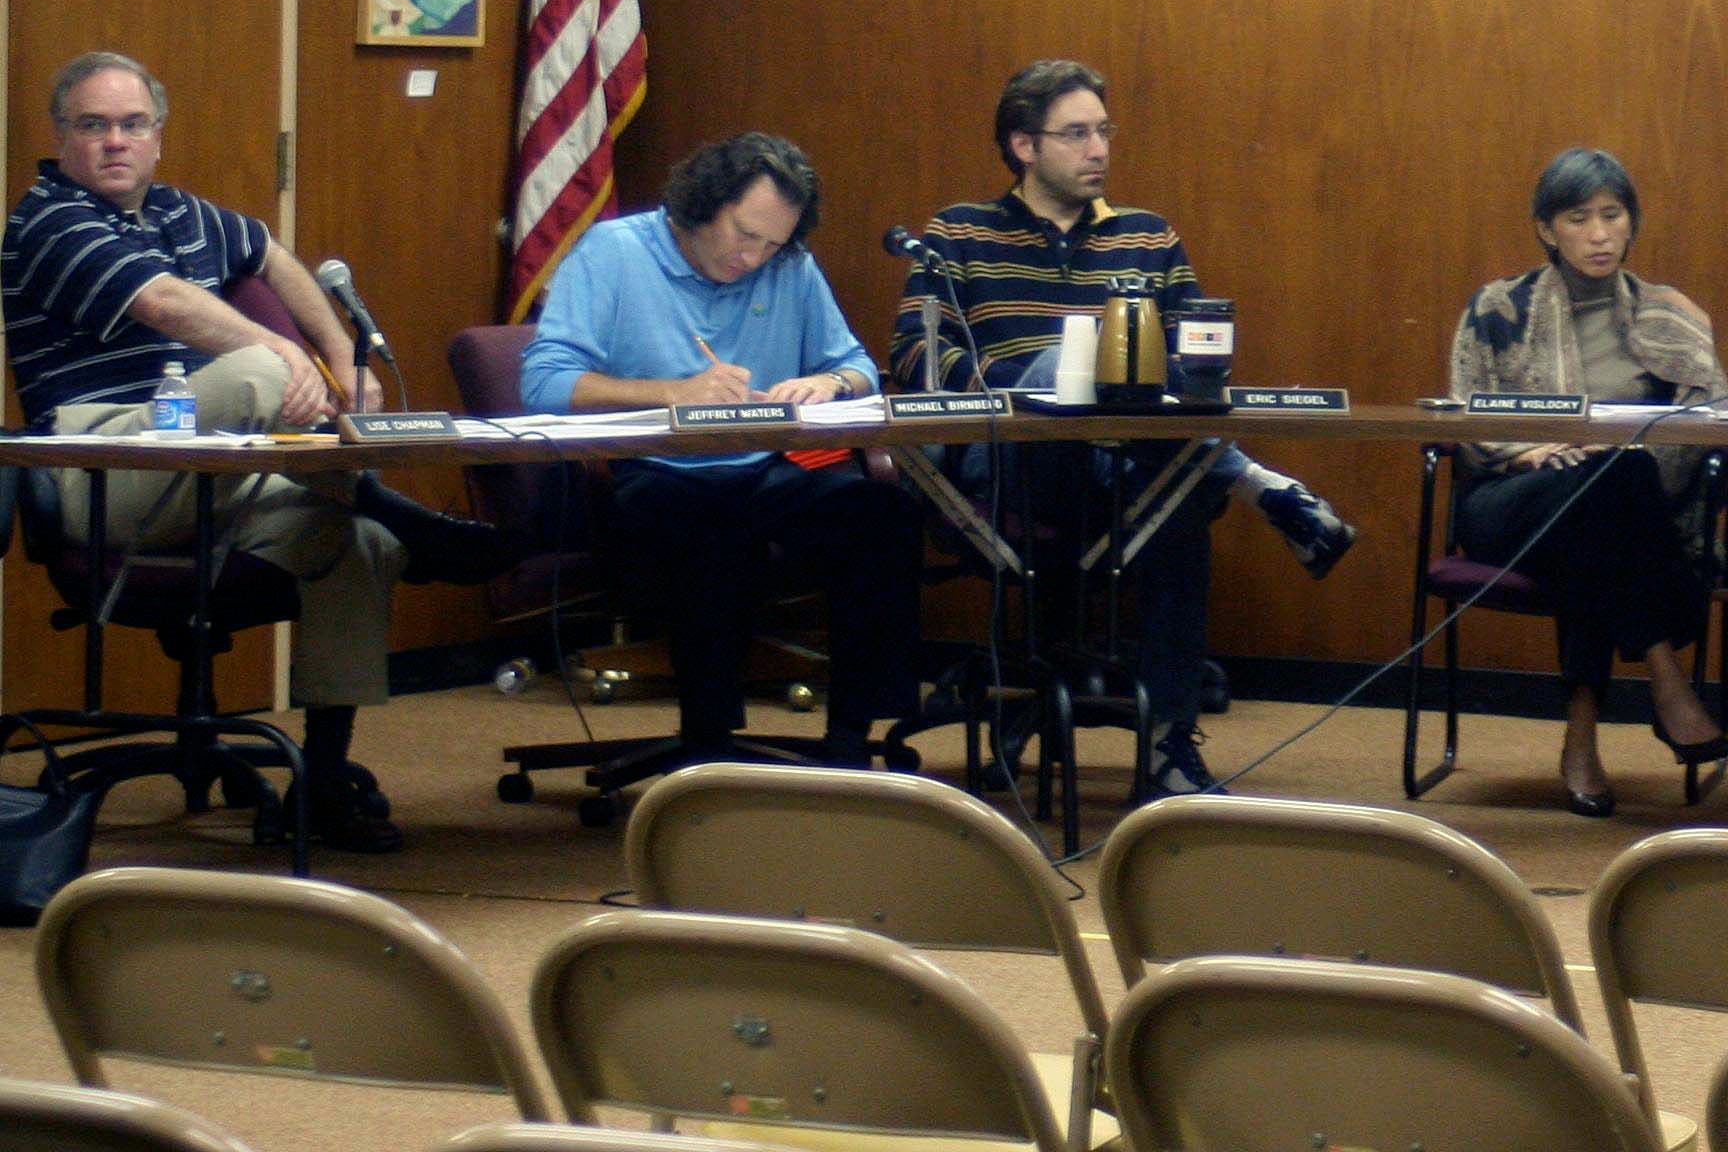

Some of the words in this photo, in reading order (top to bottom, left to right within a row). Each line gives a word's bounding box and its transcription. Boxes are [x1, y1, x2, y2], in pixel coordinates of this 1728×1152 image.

[1245, 393, 1277, 404] ERIC
[1282, 394, 1329, 405] SIEGEL
[1473, 398, 1518, 408] ELAINE
[895, 401, 946, 413] MICHAEL
[687, 409, 737, 421] JEFFREY
[740, 407, 785, 418] WATERS
[392, 419, 446, 430] CHAPMAN
